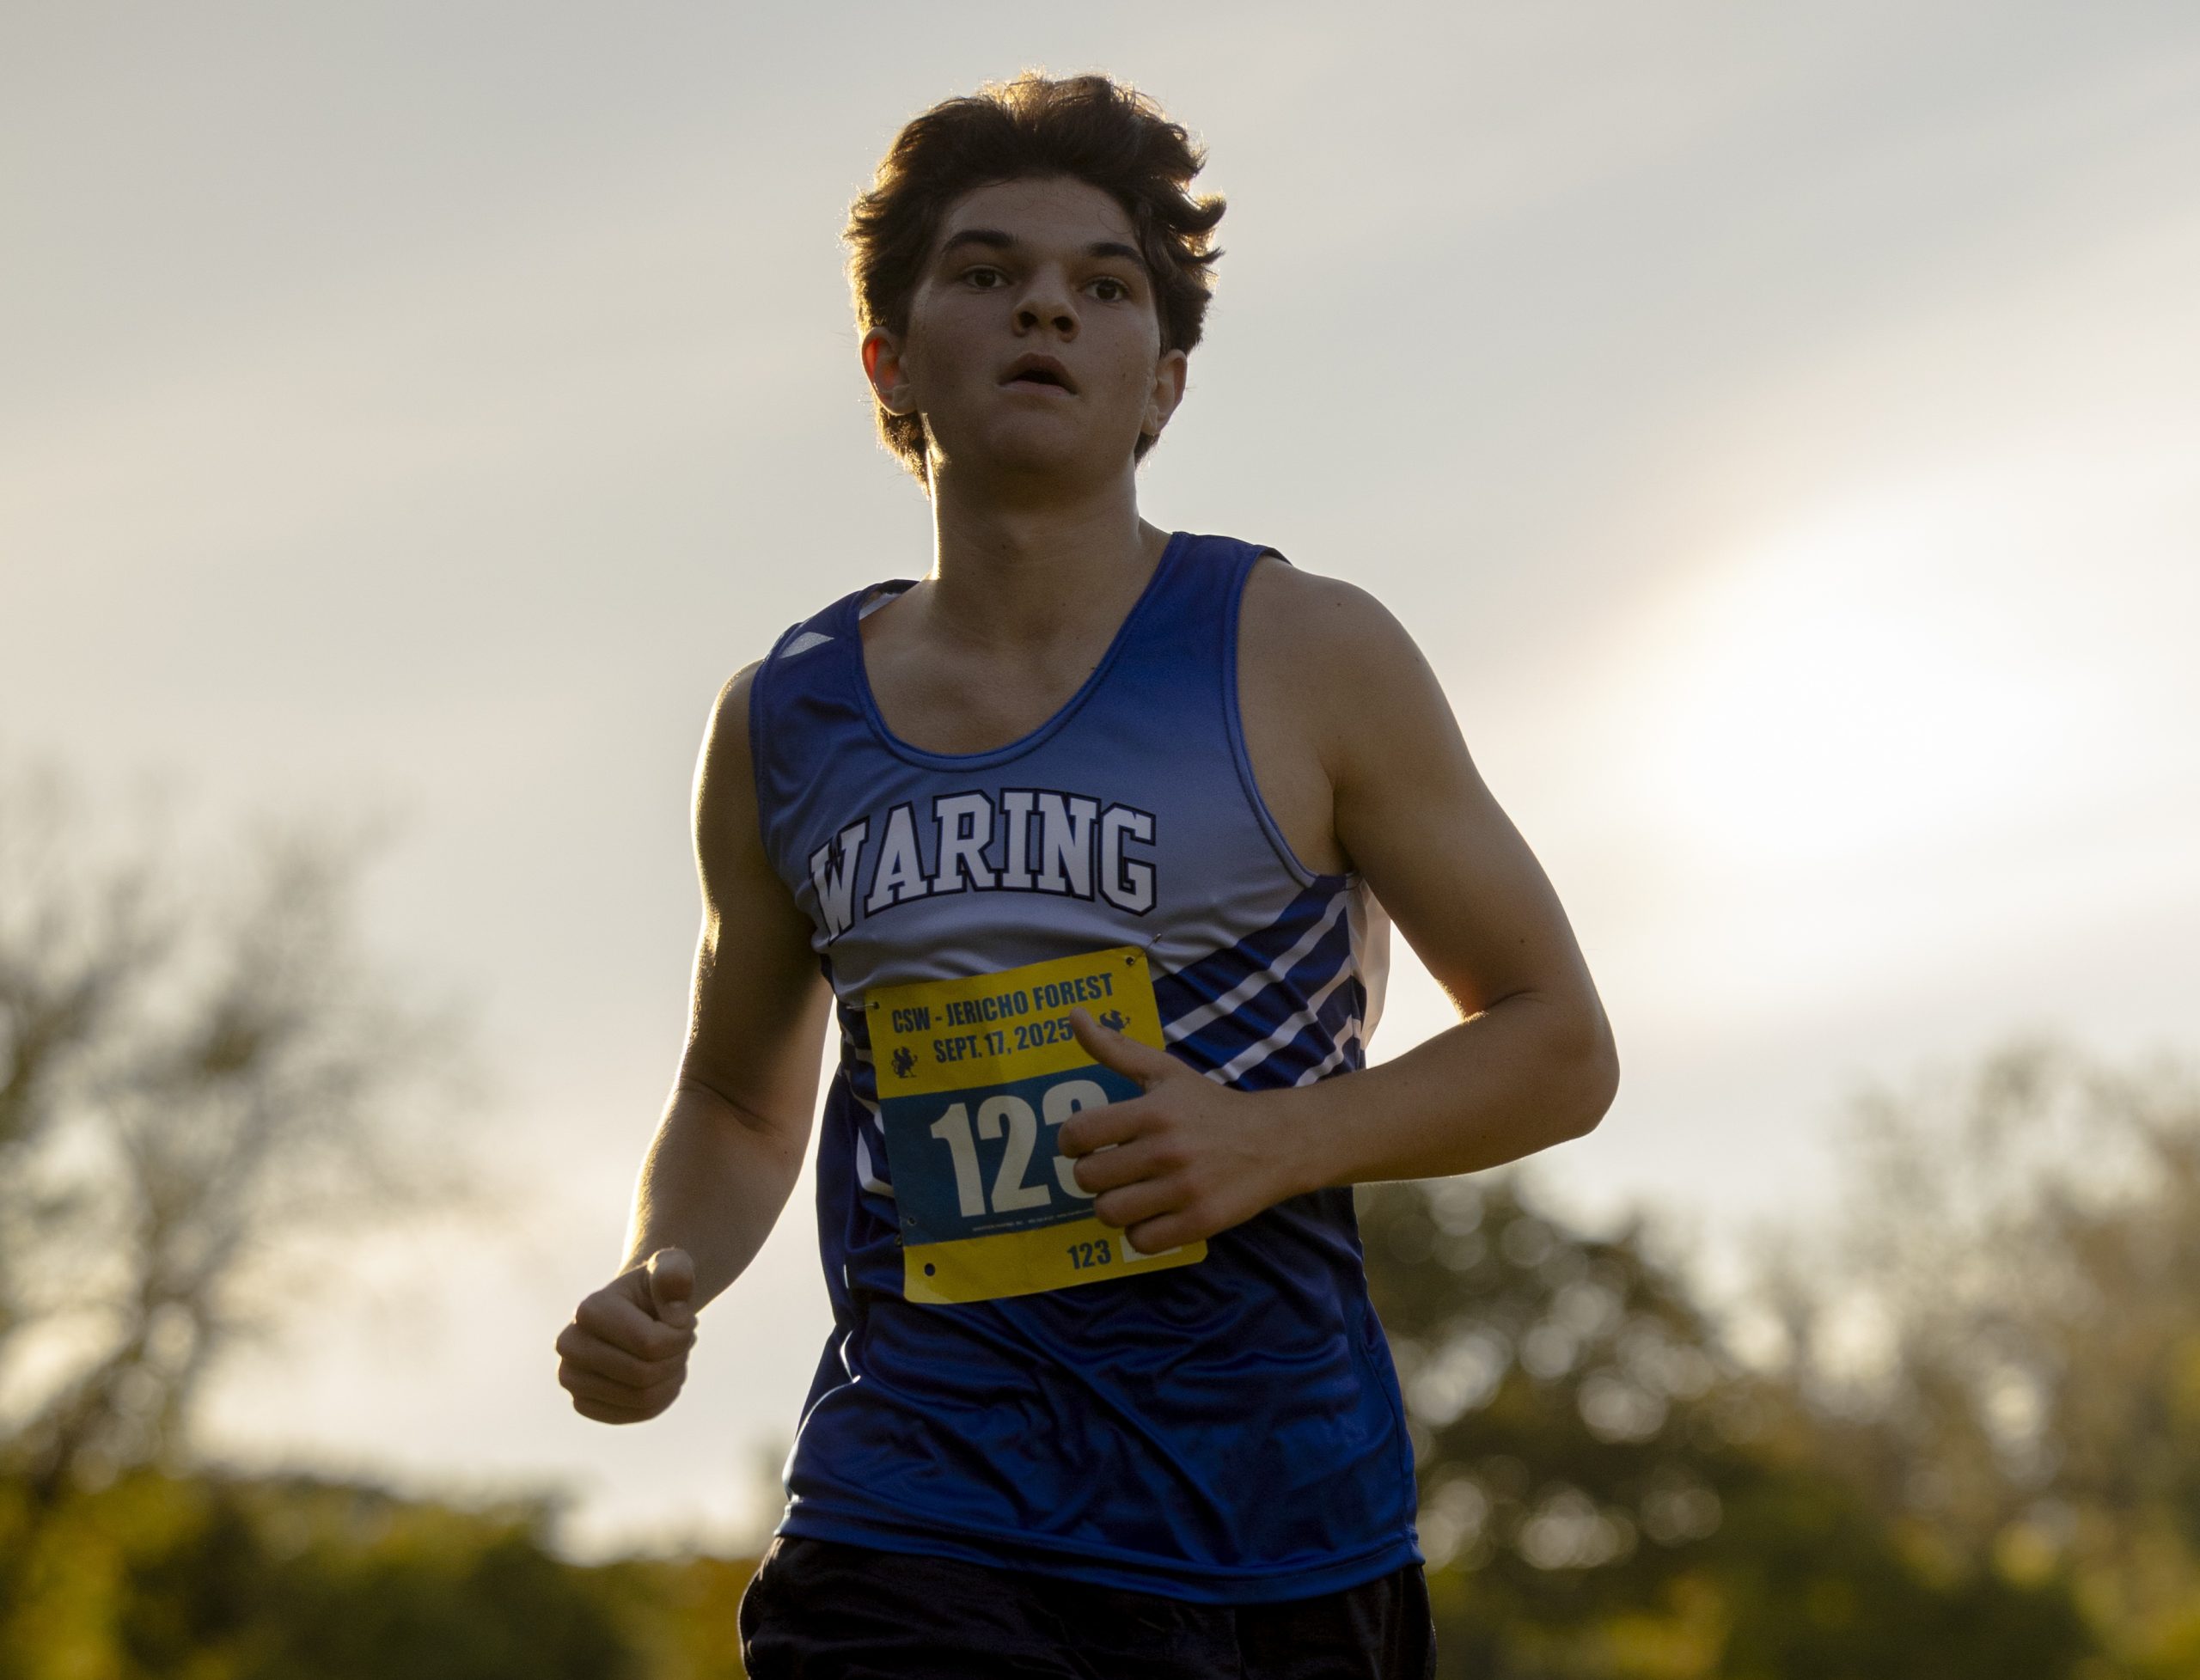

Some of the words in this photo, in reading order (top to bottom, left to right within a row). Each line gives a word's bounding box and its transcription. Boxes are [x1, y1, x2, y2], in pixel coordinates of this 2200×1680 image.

[809, 787, 1157, 945] WARING
[891, 1006, 931, 1034] CSW
[946, 990, 1030, 1028] JERICHO
[1033, 972, 1114, 1011] FOREST
[933, 1034, 983, 1064] SEPT.
[983, 1030, 1012, 1057] 17,
[1014, 1016, 1074, 1051] 2025
[1066, 1238, 1112, 1270] 123
